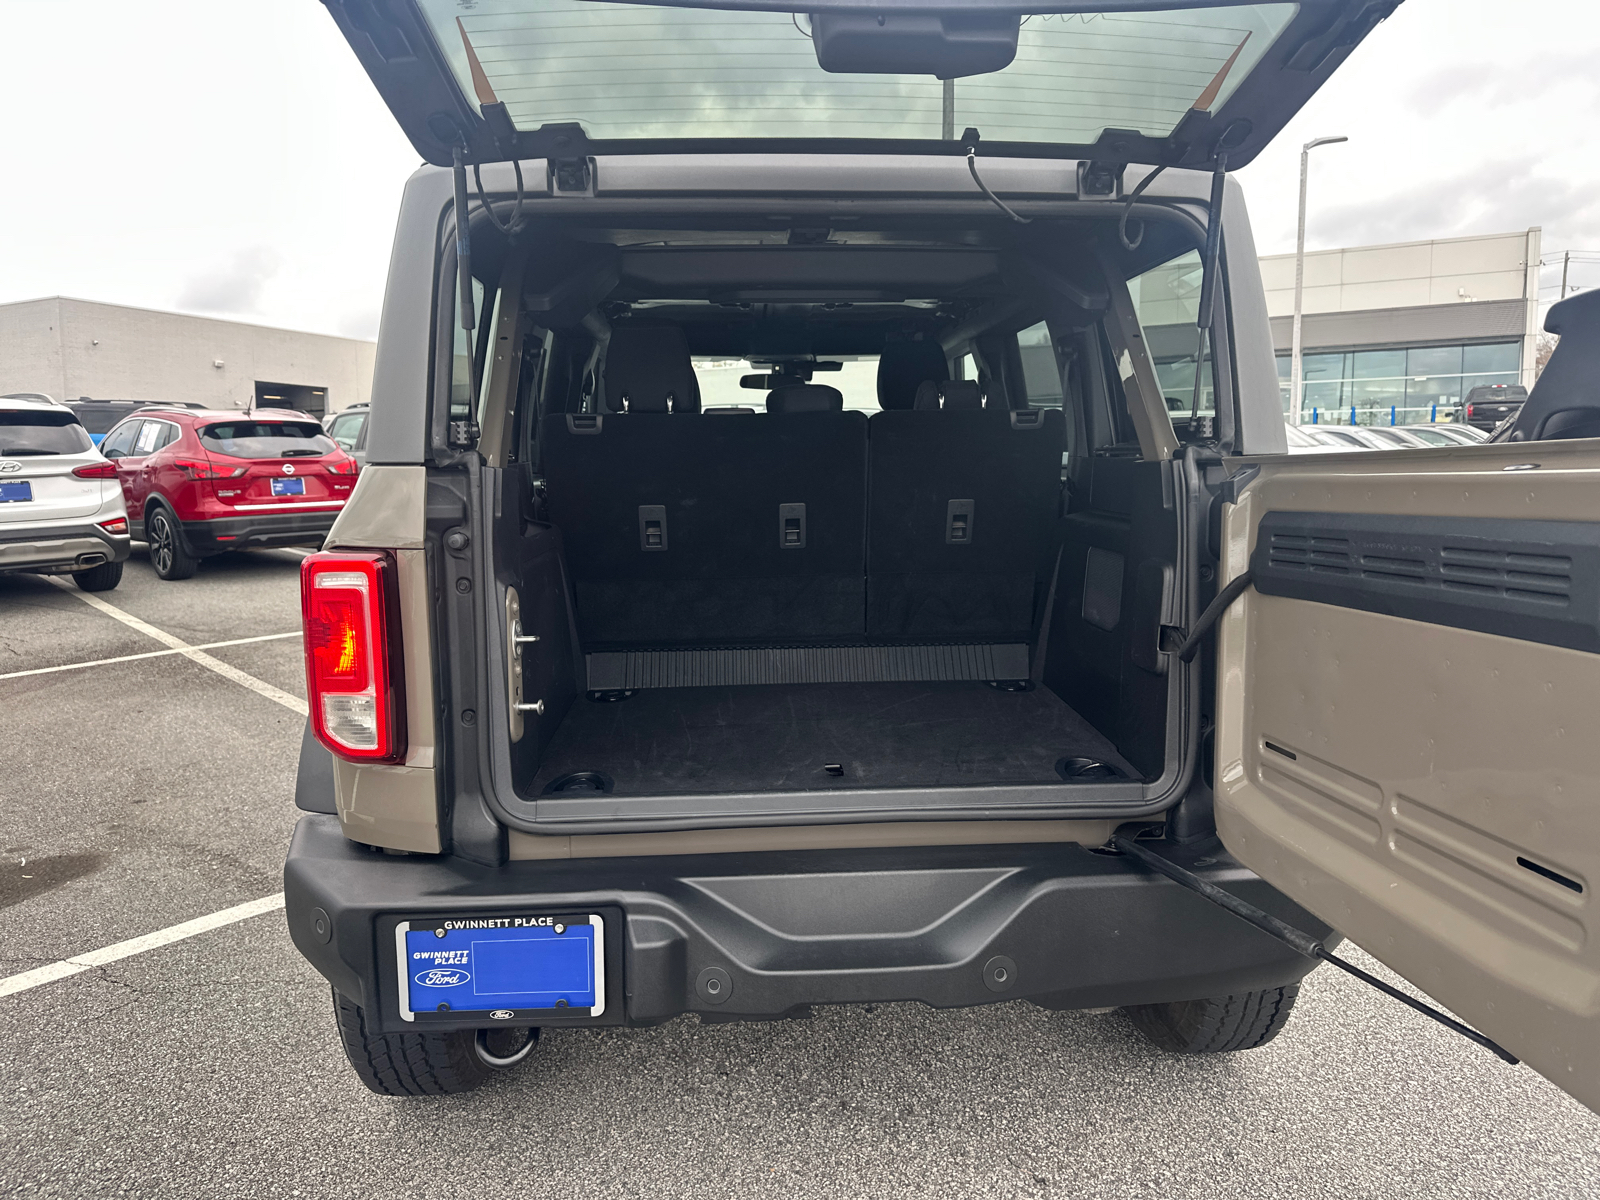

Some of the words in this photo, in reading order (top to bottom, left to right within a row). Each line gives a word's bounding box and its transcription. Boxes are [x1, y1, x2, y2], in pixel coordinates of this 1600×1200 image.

[444, 919, 510, 930] GWINNETT
[514, 917, 553, 927] PLACE
[413, 951, 469, 959] GWINNETT
[434, 957, 468, 965] PLACE
[425, 971, 460, 984] Ford
